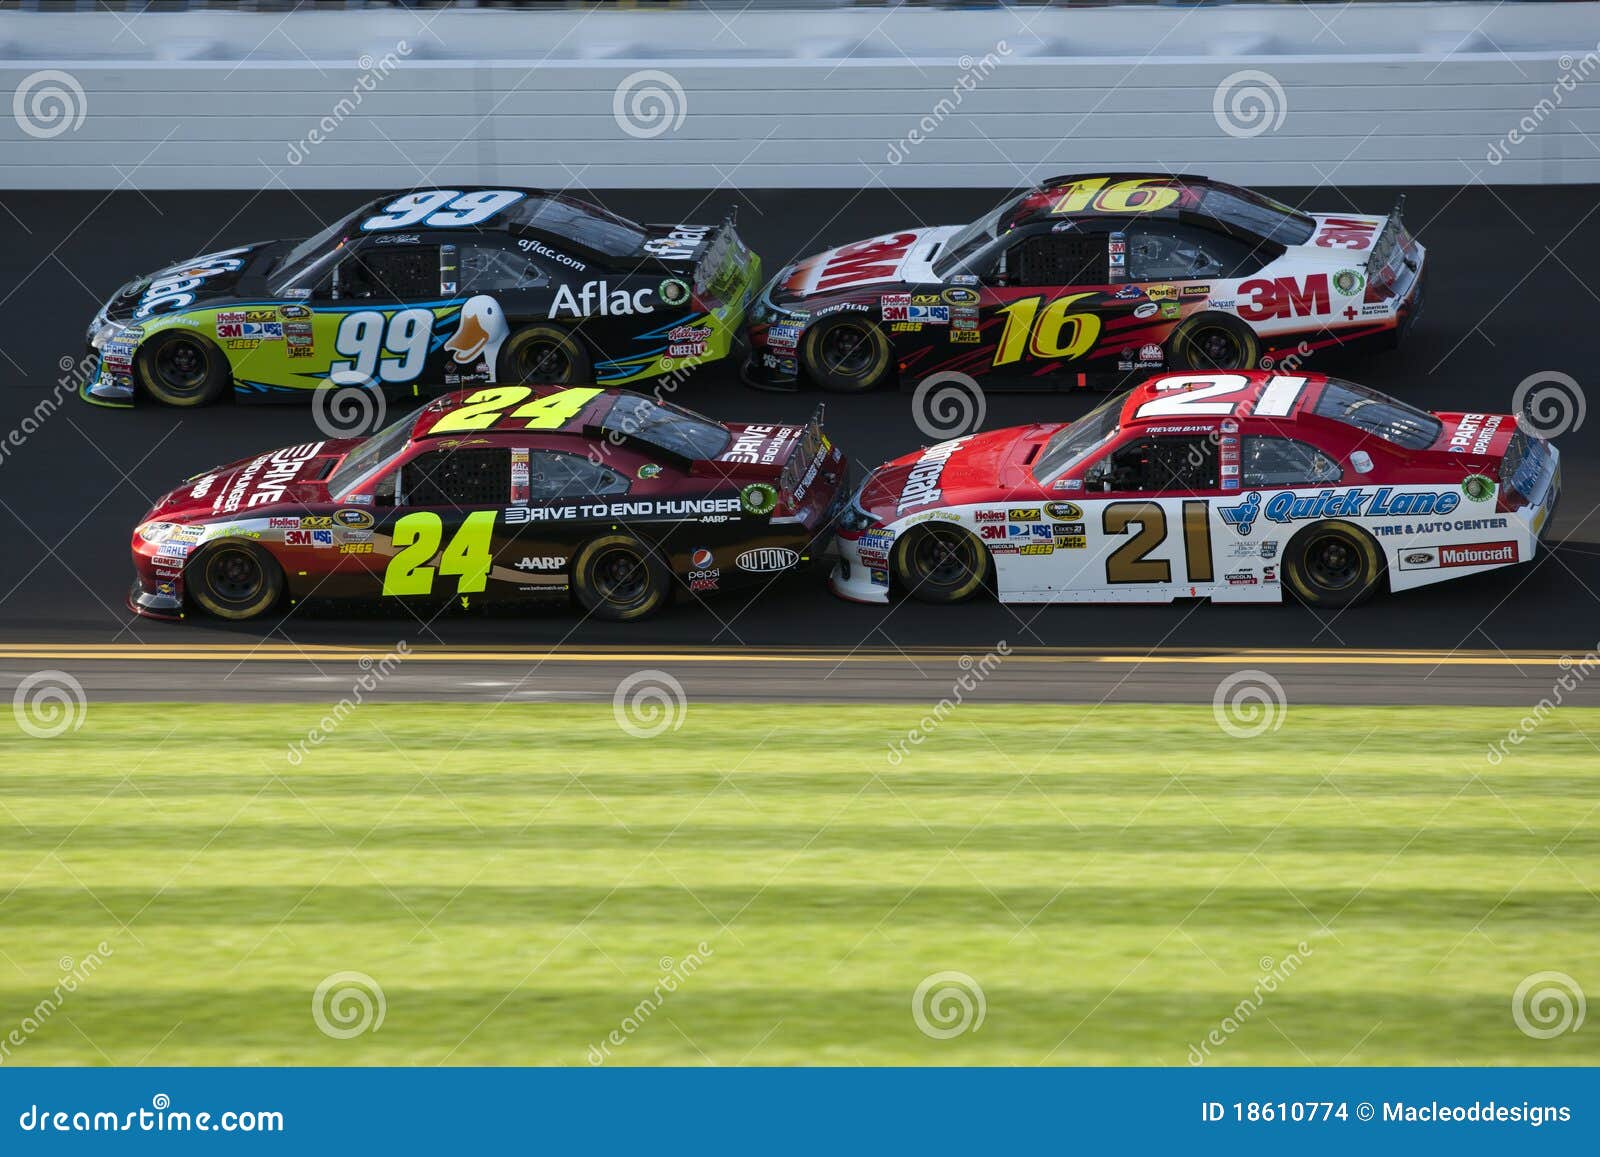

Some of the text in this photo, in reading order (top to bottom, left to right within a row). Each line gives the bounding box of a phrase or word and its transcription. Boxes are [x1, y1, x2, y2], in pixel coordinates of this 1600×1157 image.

[1052, 177, 1180, 214] 16
[360, 189, 527, 231] 99
[518, 237, 586, 272] aflac.com
[548, 280, 655, 319] Aflac
[882, 296, 911, 304] Holley
[1237, 273, 1331, 322] 3M
[817, 302, 869, 317] GOODYEAR
[883, 307, 907, 319] 3M
[930, 307, 948, 320] USG
[218, 325, 242, 338] 3M
[668, 326, 712, 341] Kellogg's
[992, 292, 1101, 368] 16
[328, 309, 434, 386] 99
[1134, 373, 1309, 419] 21
[428, 386, 605, 434] 24
[1450, 414, 1485, 446] PARTS
[580, 504, 609, 519] TO
[611, 501, 653, 516] END
[656, 498, 741, 515] HUNGER
[1264, 489, 1367, 524] Quick
[1365, 487, 1461, 518] Lane
[269, 518, 299, 528] Holley
[700, 515, 728, 523] AARP
[975, 510, 1006, 521] Holley
[980, 525, 1007, 539] 3M
[1032, 524, 1052, 539] USG
[1373, 518, 1508, 537] TIRE & AUTO CENTER
[285, 531, 312, 545] 3M
[313, 531, 332, 545] USG
[858, 538, 890, 549] MAHLE
[1102, 499, 1214, 585] 21
[382, 510, 499, 597] 24
[1020, 544, 1054, 555] JEGS
[1443, 547, 1513, 564] Motorcraft
[514, 556, 566, 570] AARP
[1408, 553, 1430, 564] Ford
[688, 568, 720, 580] pepsi
